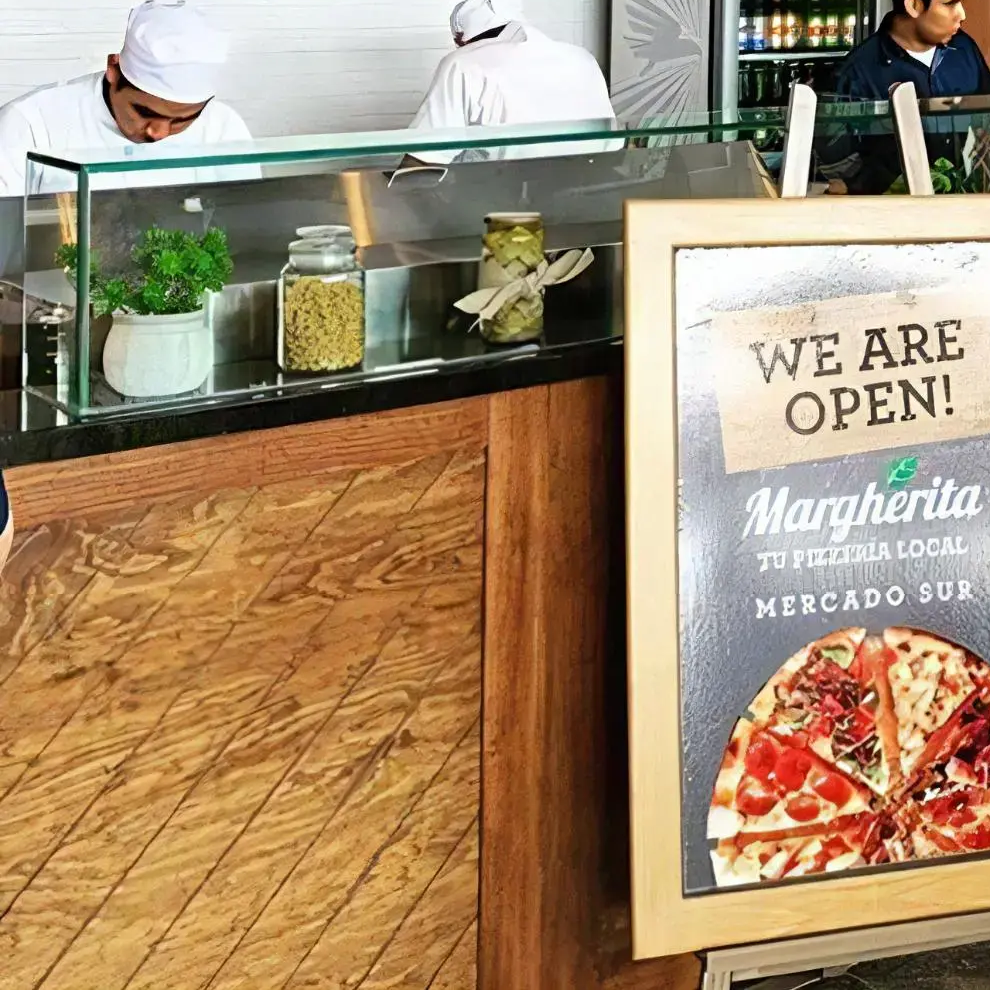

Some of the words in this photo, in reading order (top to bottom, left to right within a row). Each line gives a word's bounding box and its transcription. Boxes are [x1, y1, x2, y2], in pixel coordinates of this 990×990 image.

[749, 332, 843, 384] WE
[859, 319, 965, 372] ARE
[785, 374, 955, 435] OPEN!
[742, 476, 984, 542] Margherita
[757, 549, 787, 572] TU
[897, 536, 969, 559] LOCAL
[755, 584, 906, 619] MERCADO
[919, 579, 974, 604] SUR
